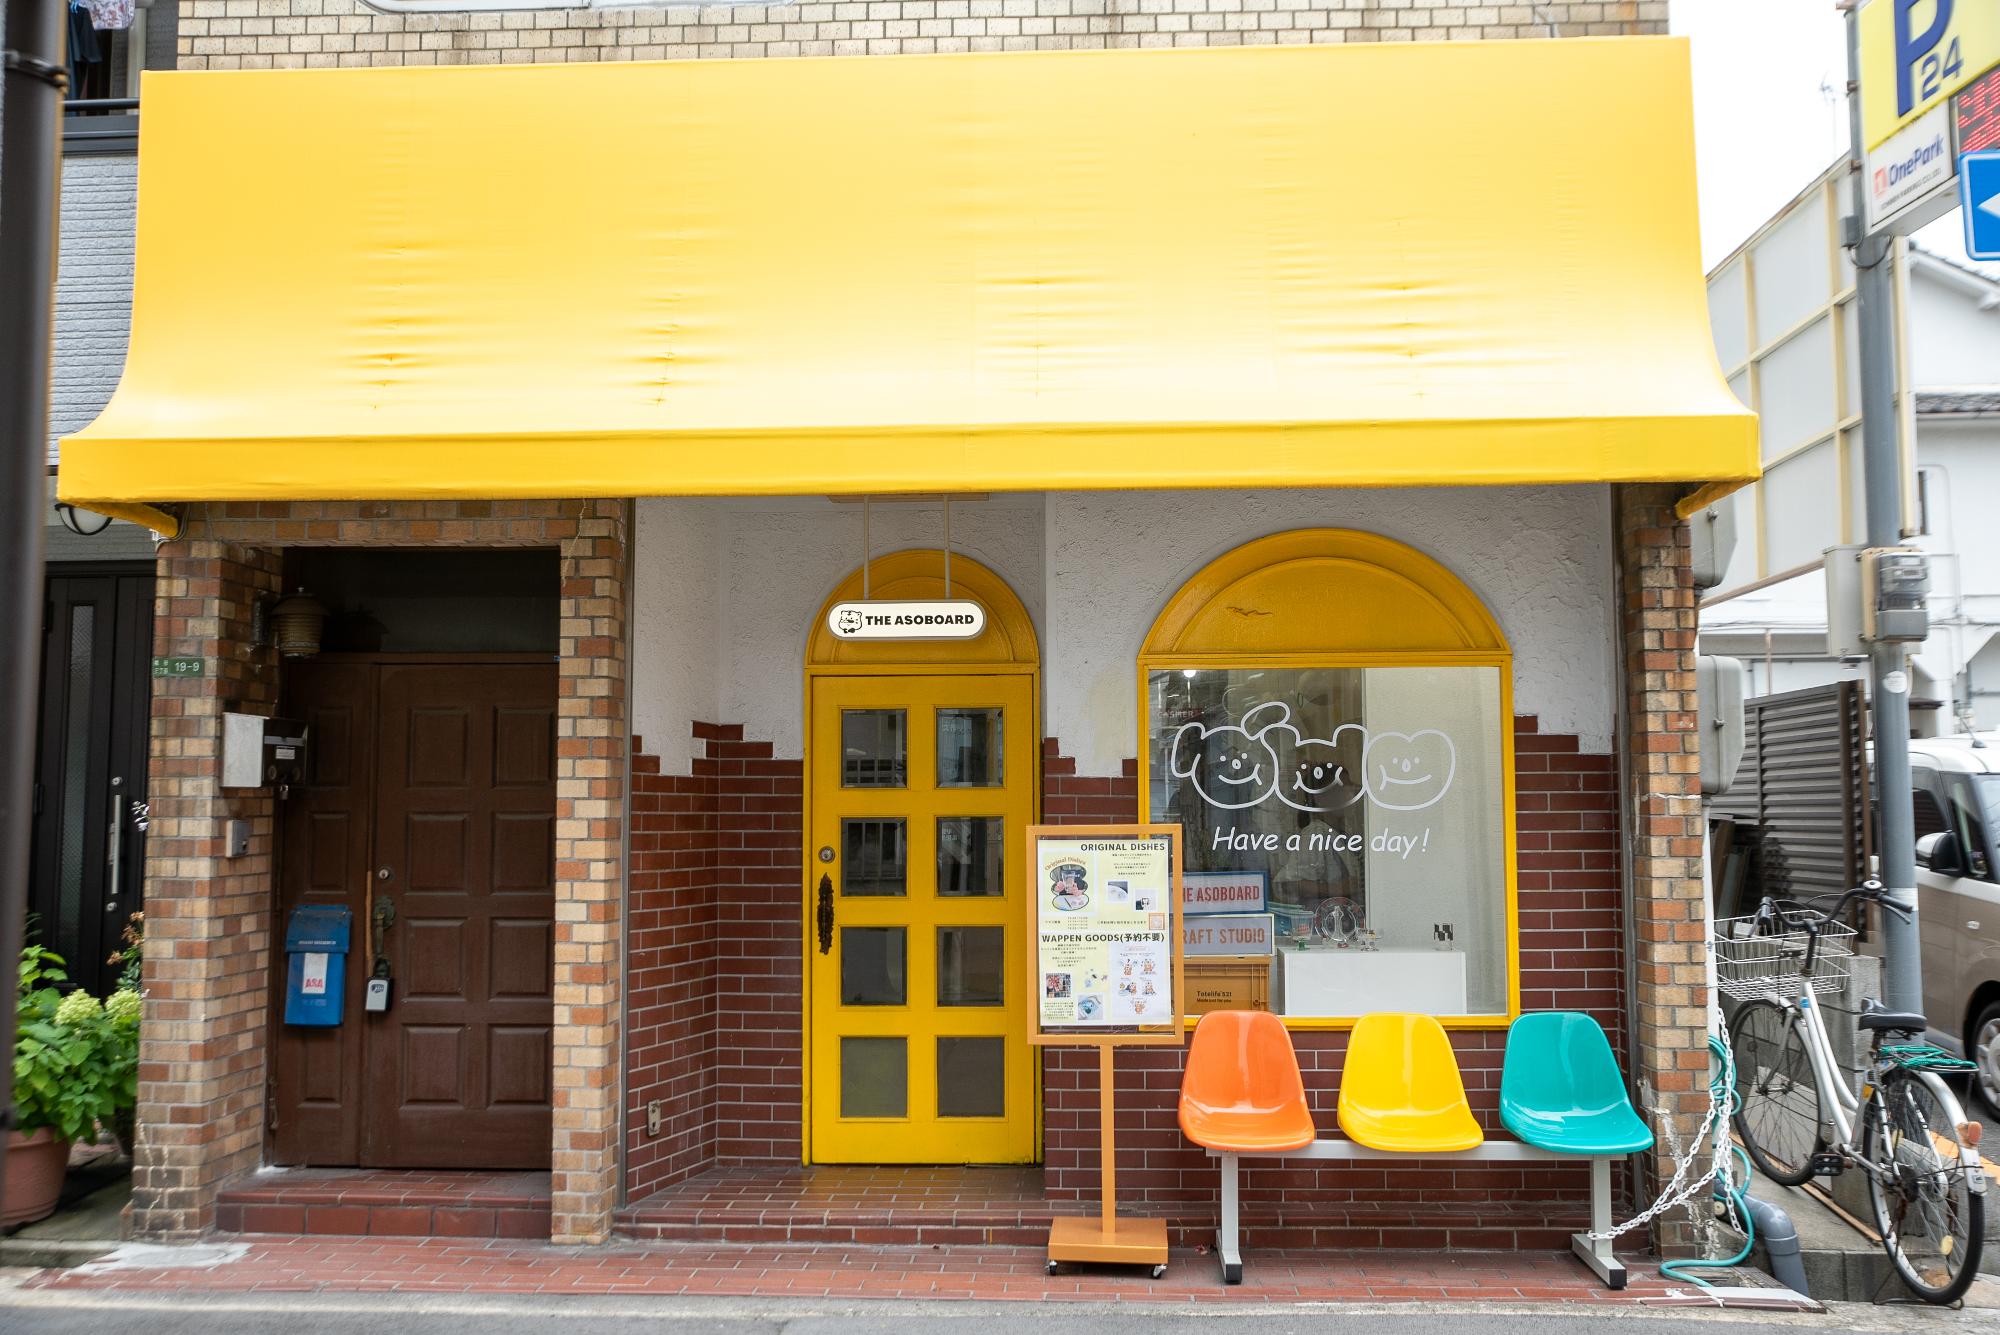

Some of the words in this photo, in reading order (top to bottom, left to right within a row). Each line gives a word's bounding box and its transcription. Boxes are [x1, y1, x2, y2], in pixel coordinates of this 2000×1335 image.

[1894, 0, 1955, 118] P
[1920, 36, 1964, 101] 24
[1888, 133, 1945, 187] OnePark
[865, 615, 892, 626] THE
[894, 614, 975, 626] ASOBOARD
[1080, 843, 1127, 852] ORIGINAL
[1130, 843, 1165, 851] DISHES
[1212, 826, 1279, 851] Have
[1285, 833, 1300, 851] a
[1308, 828, 1363, 852] nice
[1370, 827, 1430, 860] day!
[1196, 885, 1260, 902] ASOBOARD
[1042, 934, 1082, 943] WAPPEN
[1171, 928, 1213, 945] RAFT
[1219, 927, 1265, 944] STUDIO
[305, 978, 323, 988] ASA
